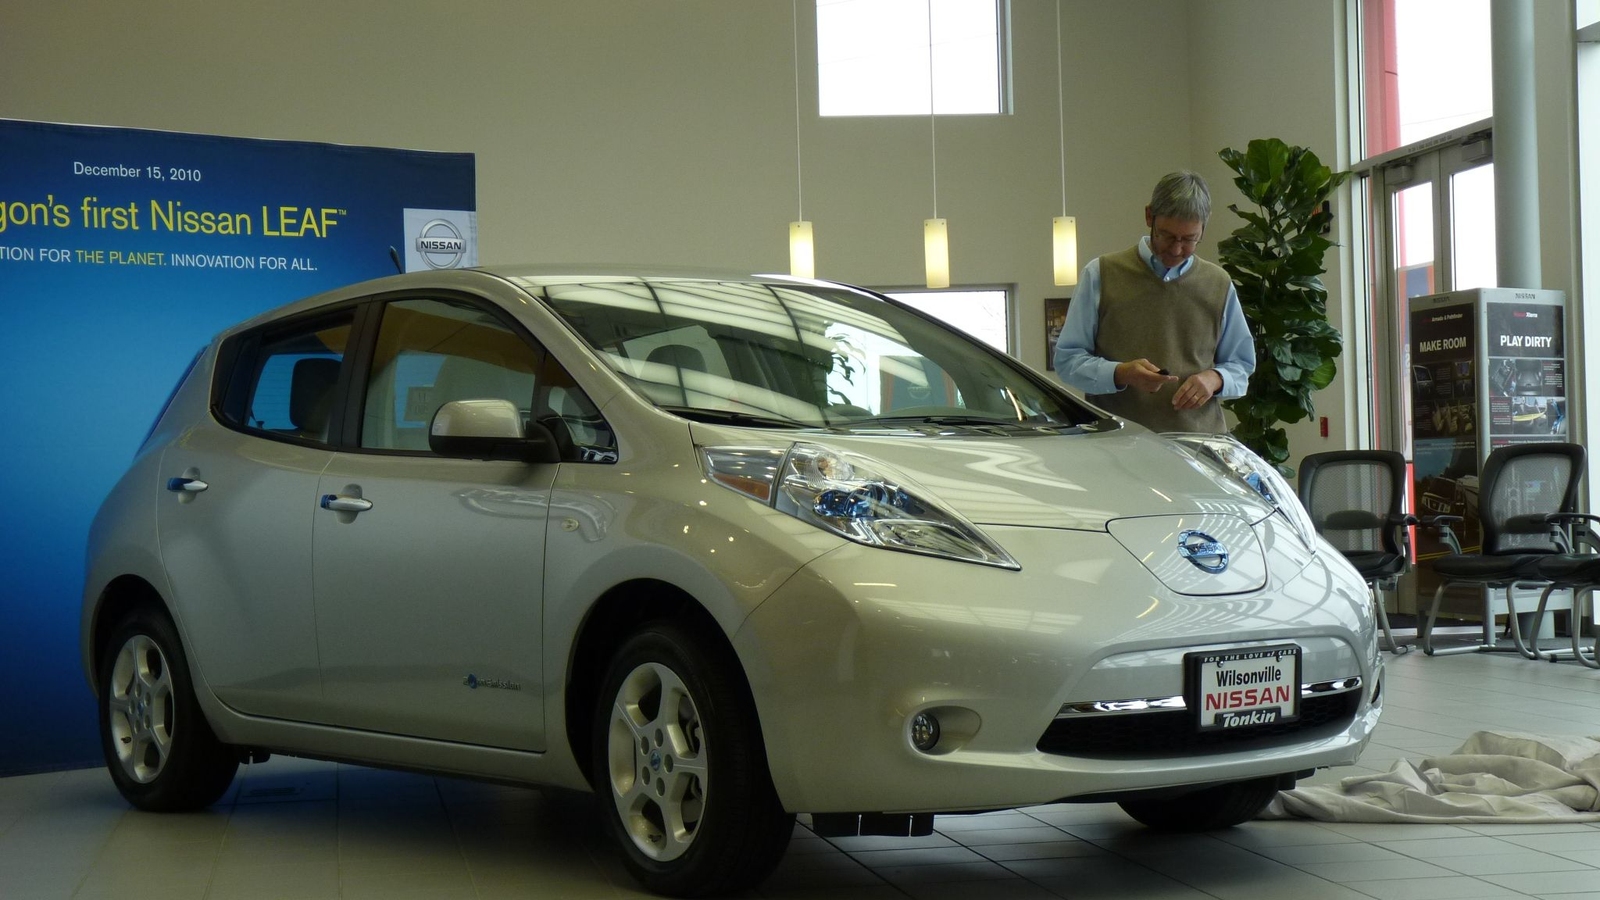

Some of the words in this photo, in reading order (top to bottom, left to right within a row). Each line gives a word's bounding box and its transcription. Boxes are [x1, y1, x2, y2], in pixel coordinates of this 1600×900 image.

[73, 161, 141, 178] December
[146, 166, 165, 181] 15,
[169, 167, 202, 181] 2010
[80, 196, 140, 230] first
[150, 199, 252, 235] Nissan
[420, 241, 462, 250] NISSAN
[39, 248, 71, 263] FOR
[75, 249, 105, 264] THE
[109, 251, 167, 266] PLANET.
[171, 253, 255, 269] INNOVATION
[259, 256, 287, 270] FOR
[291, 257, 318, 271] ALL.
[1419, 339, 1441, 353] MAKE
[1442, 336, 1467, 349] ROOM
[1500, 335, 1524, 348] PLAY
[1524, 335, 1552, 348] DIRTY
[1204, 655, 1220, 663] FOR
[1216, 666, 1282, 687] Wilsonville
[1205, 685, 1290, 711] NISSAN
[1222, 711, 1276, 728] Tonkin
